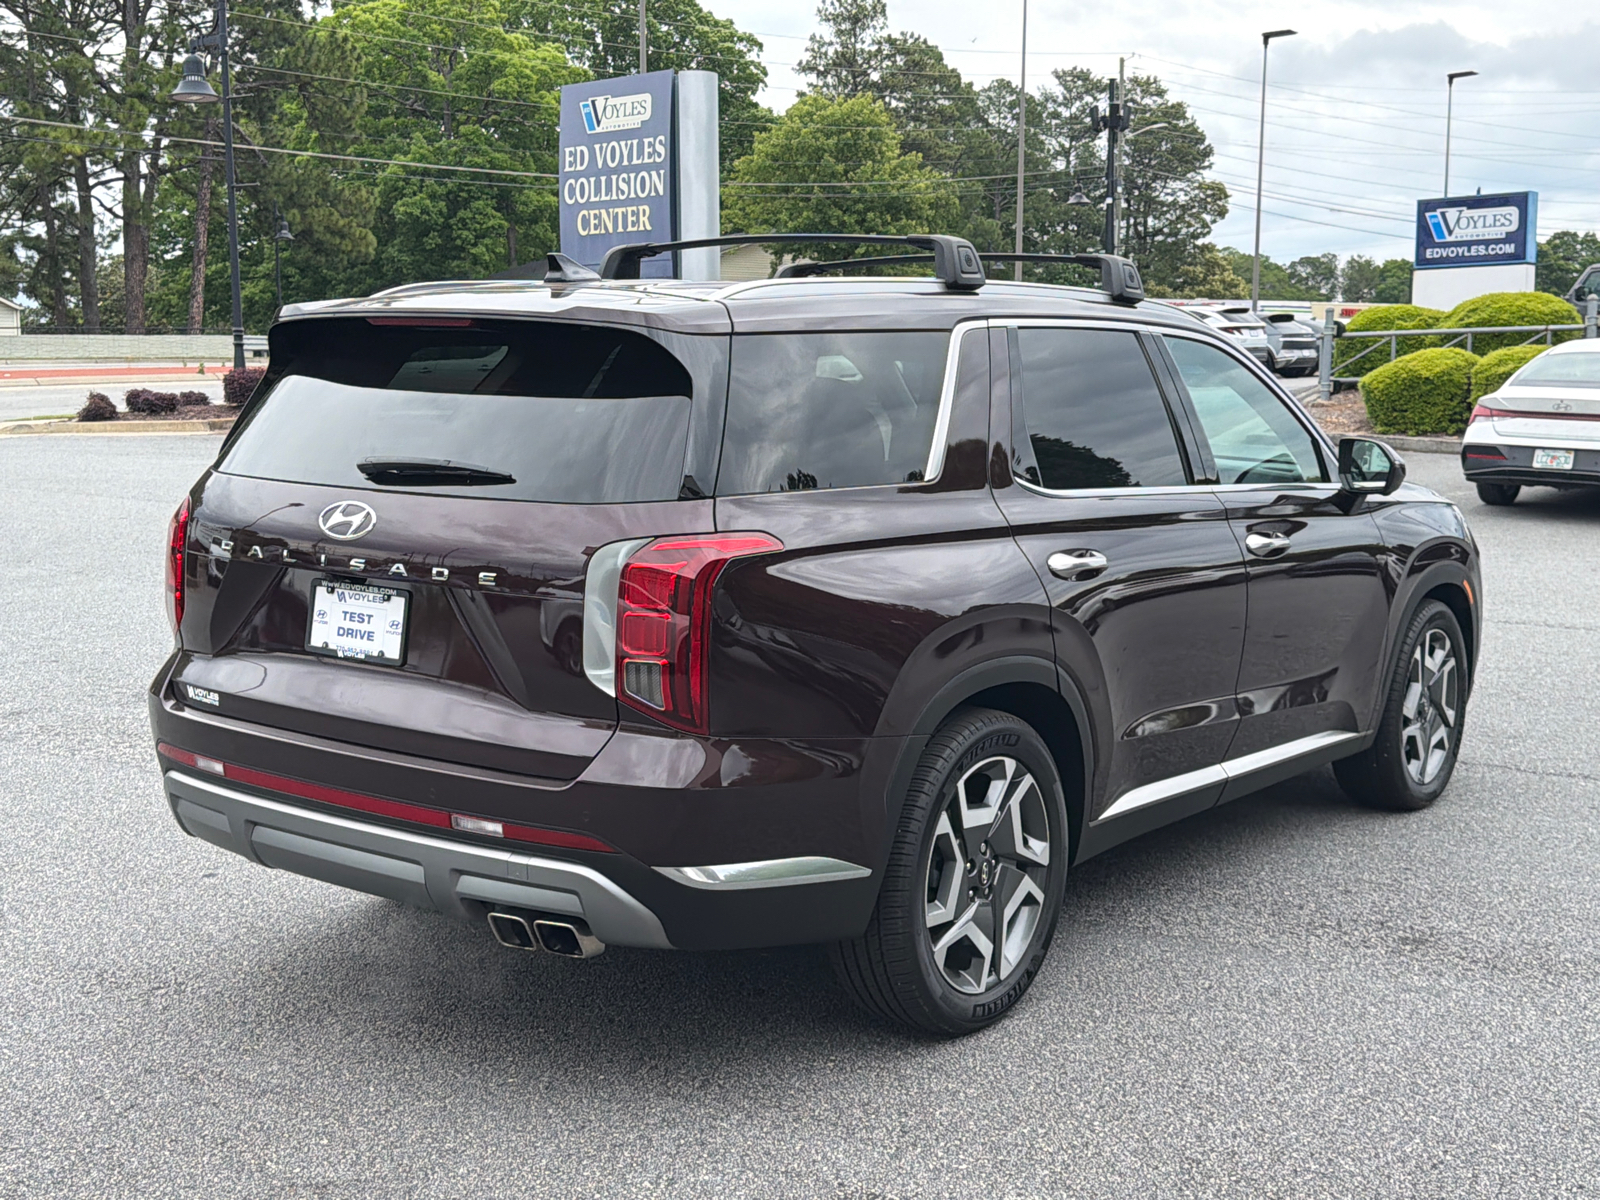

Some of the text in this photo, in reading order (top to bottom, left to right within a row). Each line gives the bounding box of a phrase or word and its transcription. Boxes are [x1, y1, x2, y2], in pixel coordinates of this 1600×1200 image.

[591, 97, 647, 127] VOYLES
[602, 122, 640, 130] AUTOMOTIVE
[564, 135, 666, 172] ED VOYLES
[564, 170, 666, 204] COLLISION
[577, 205, 652, 236] CENTER
[1440, 210, 1513, 237] VOYLES
[1426, 243, 1515, 258] EDVOYLES.COM
[221, 540, 498, 586] PALISADE
[348, 592, 384, 604] VOYLES
[341, 610, 374, 625] TEST
[337, 627, 375, 642] DRIVE
